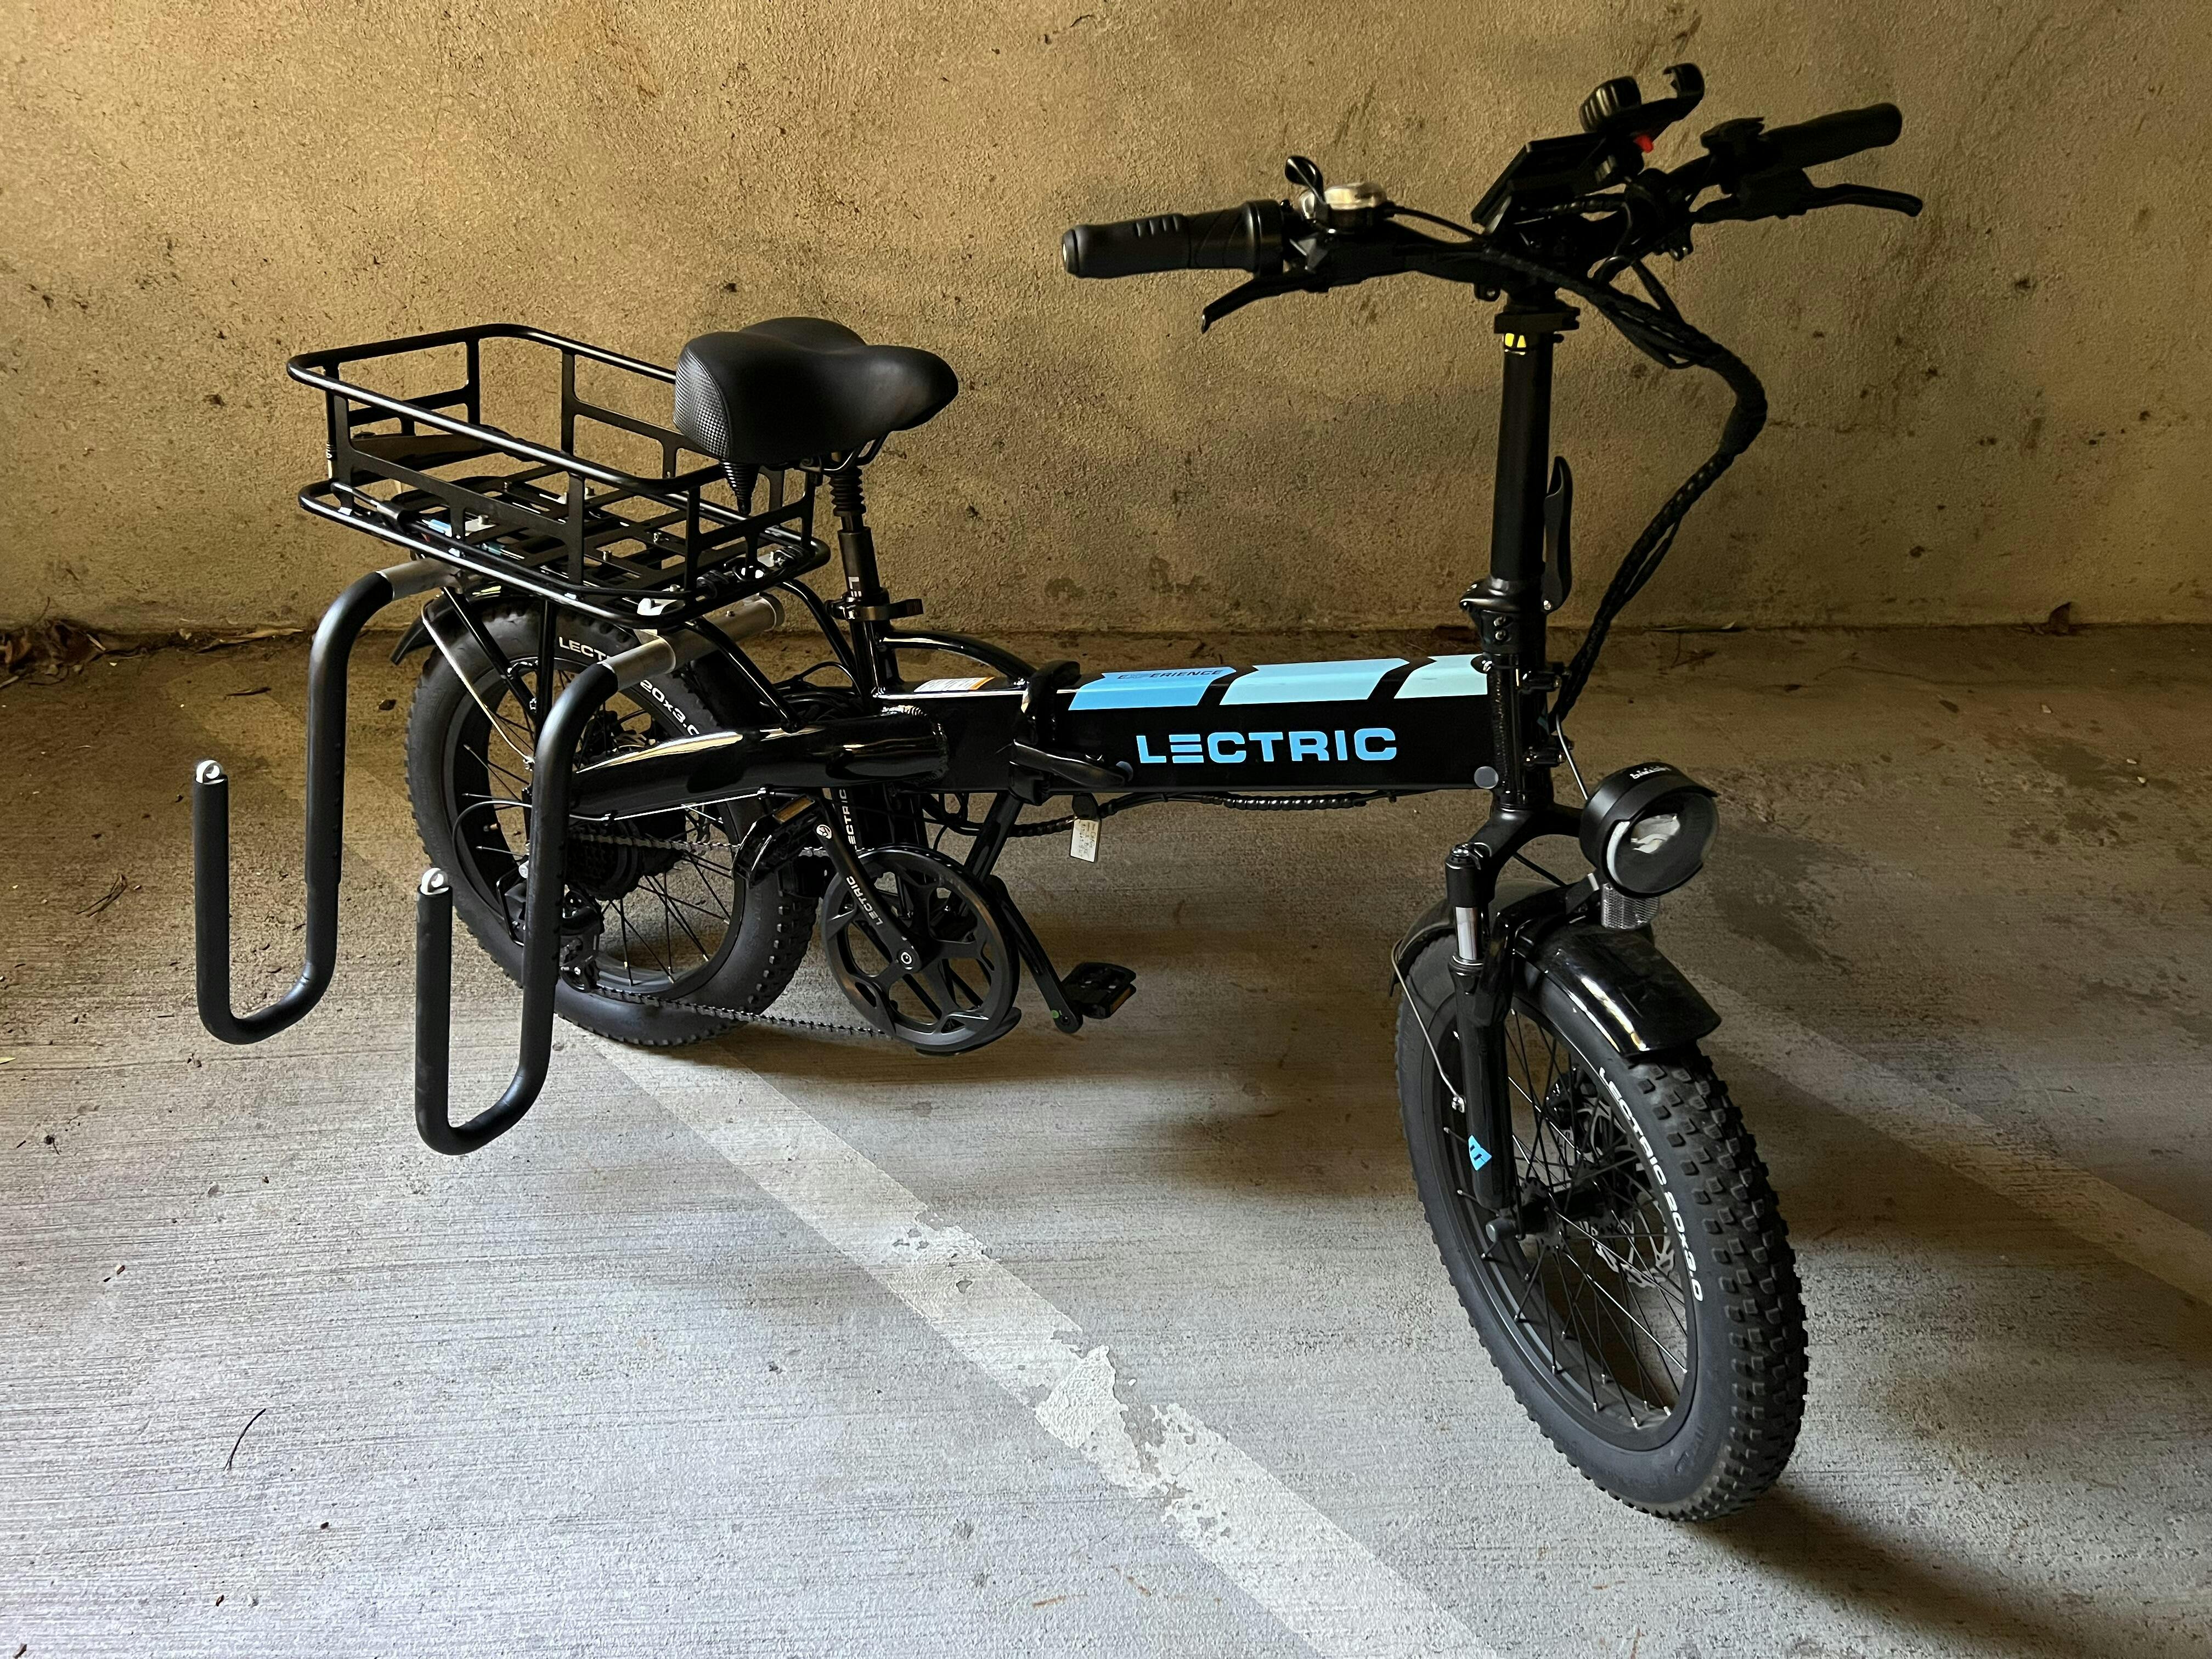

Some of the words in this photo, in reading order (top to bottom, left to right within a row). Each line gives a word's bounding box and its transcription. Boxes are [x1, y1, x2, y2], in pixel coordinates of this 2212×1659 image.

[559, 636, 607, 661] LECT
[1136, 727, 1397, 763] LECTRIC
[846, 876, 883, 925] LECTRIC
[1599, 1066, 1667, 1186] LECTRIC
[1664, 1191, 1703, 1301] 20x3.0
